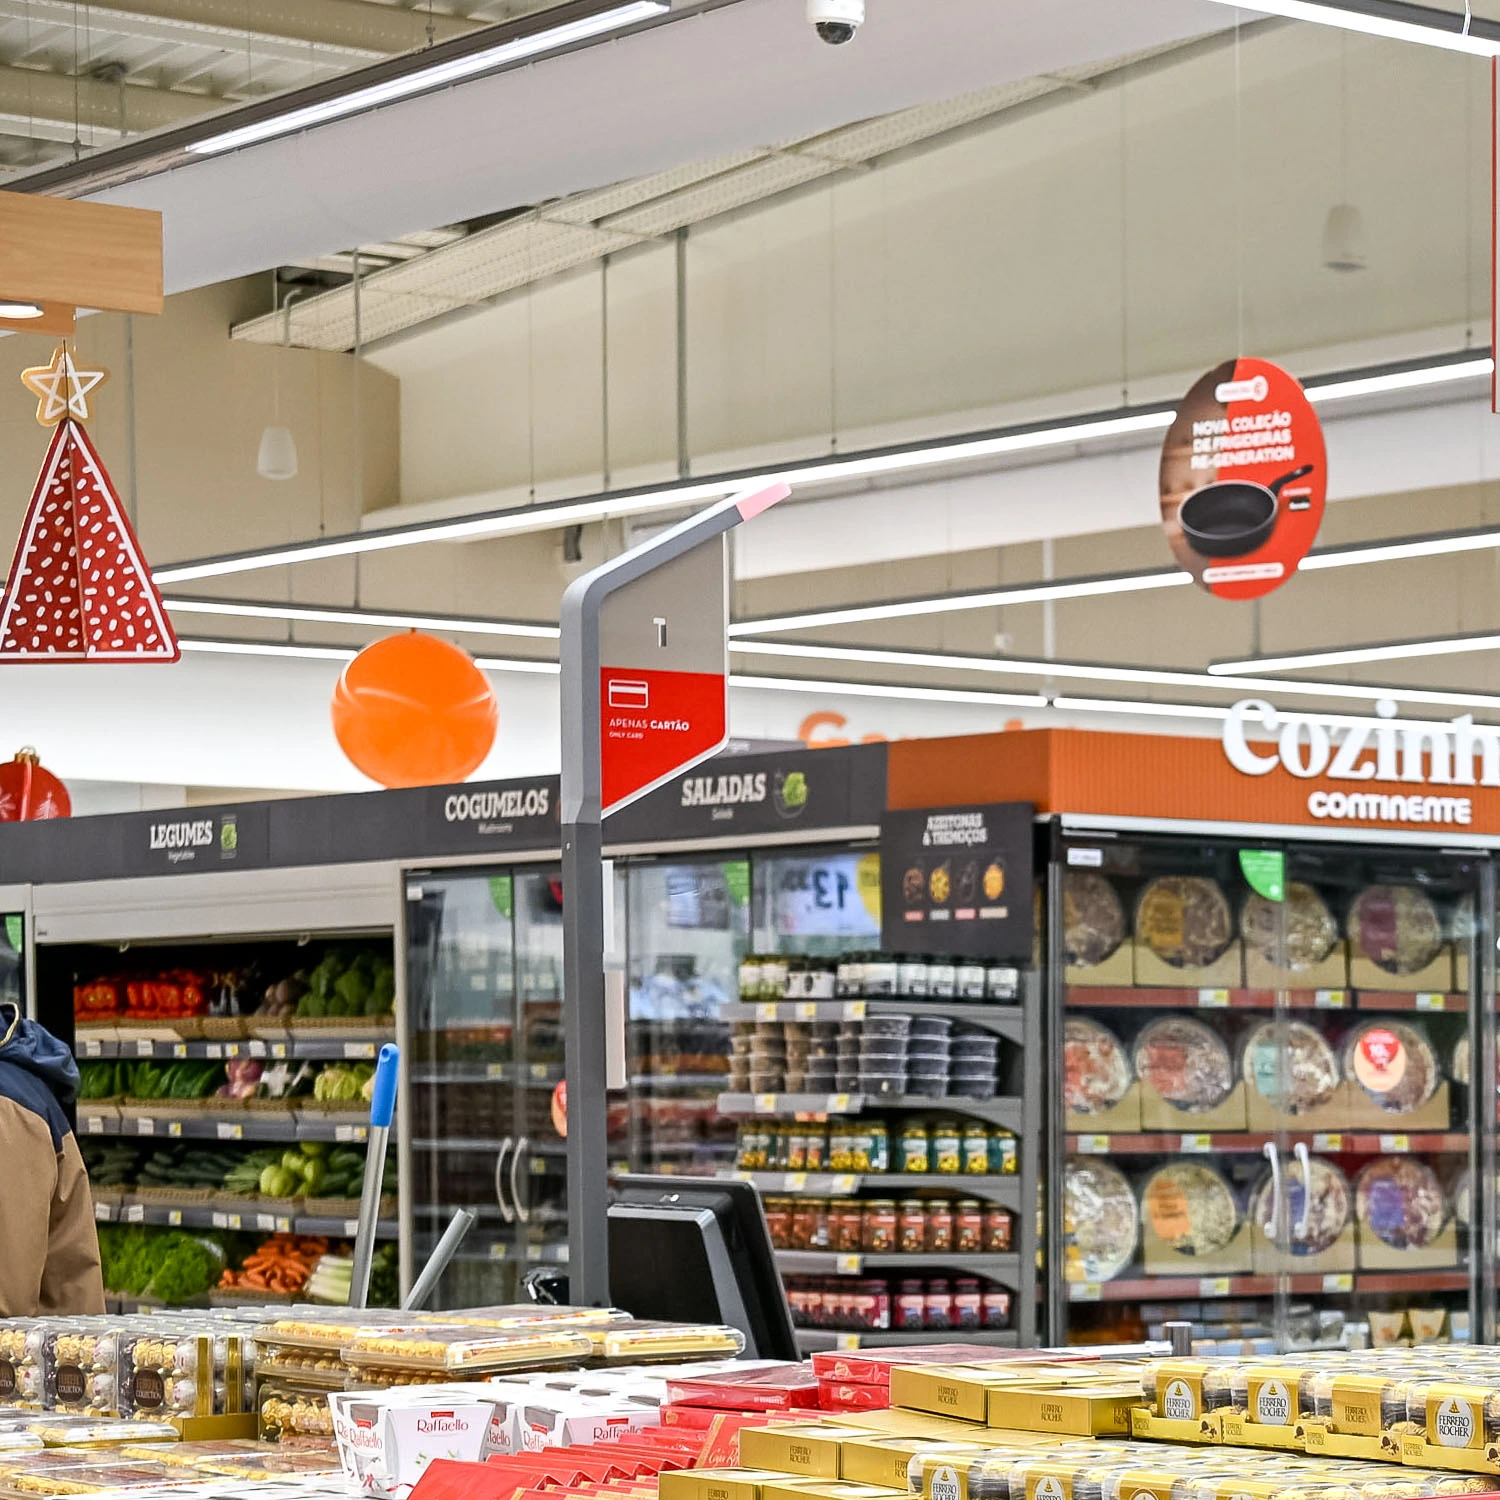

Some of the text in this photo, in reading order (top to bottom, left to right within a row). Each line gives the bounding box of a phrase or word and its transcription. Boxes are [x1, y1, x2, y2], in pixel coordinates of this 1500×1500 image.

[1193, 410, 1292, 436] NOVA COLEÇÃO
[609, 718, 690, 731] APENAS CARTÃO
[681, 773, 767, 807] SALADAS
[444, 788, 549, 822] COGUMELOS
[1307, 792, 1472, 824] CONTINENTE
[150, 820, 213, 850] LEGUMES
[416, 1416, 469, 1433] Raffaello
[1439, 1414, 1470, 1428] FERRERO
[1439, 1424, 1470, 1439] ROCHER
[349, 1429, 383, 1450] Raffaello
[932, 1483, 957, 1495] FERRERO
